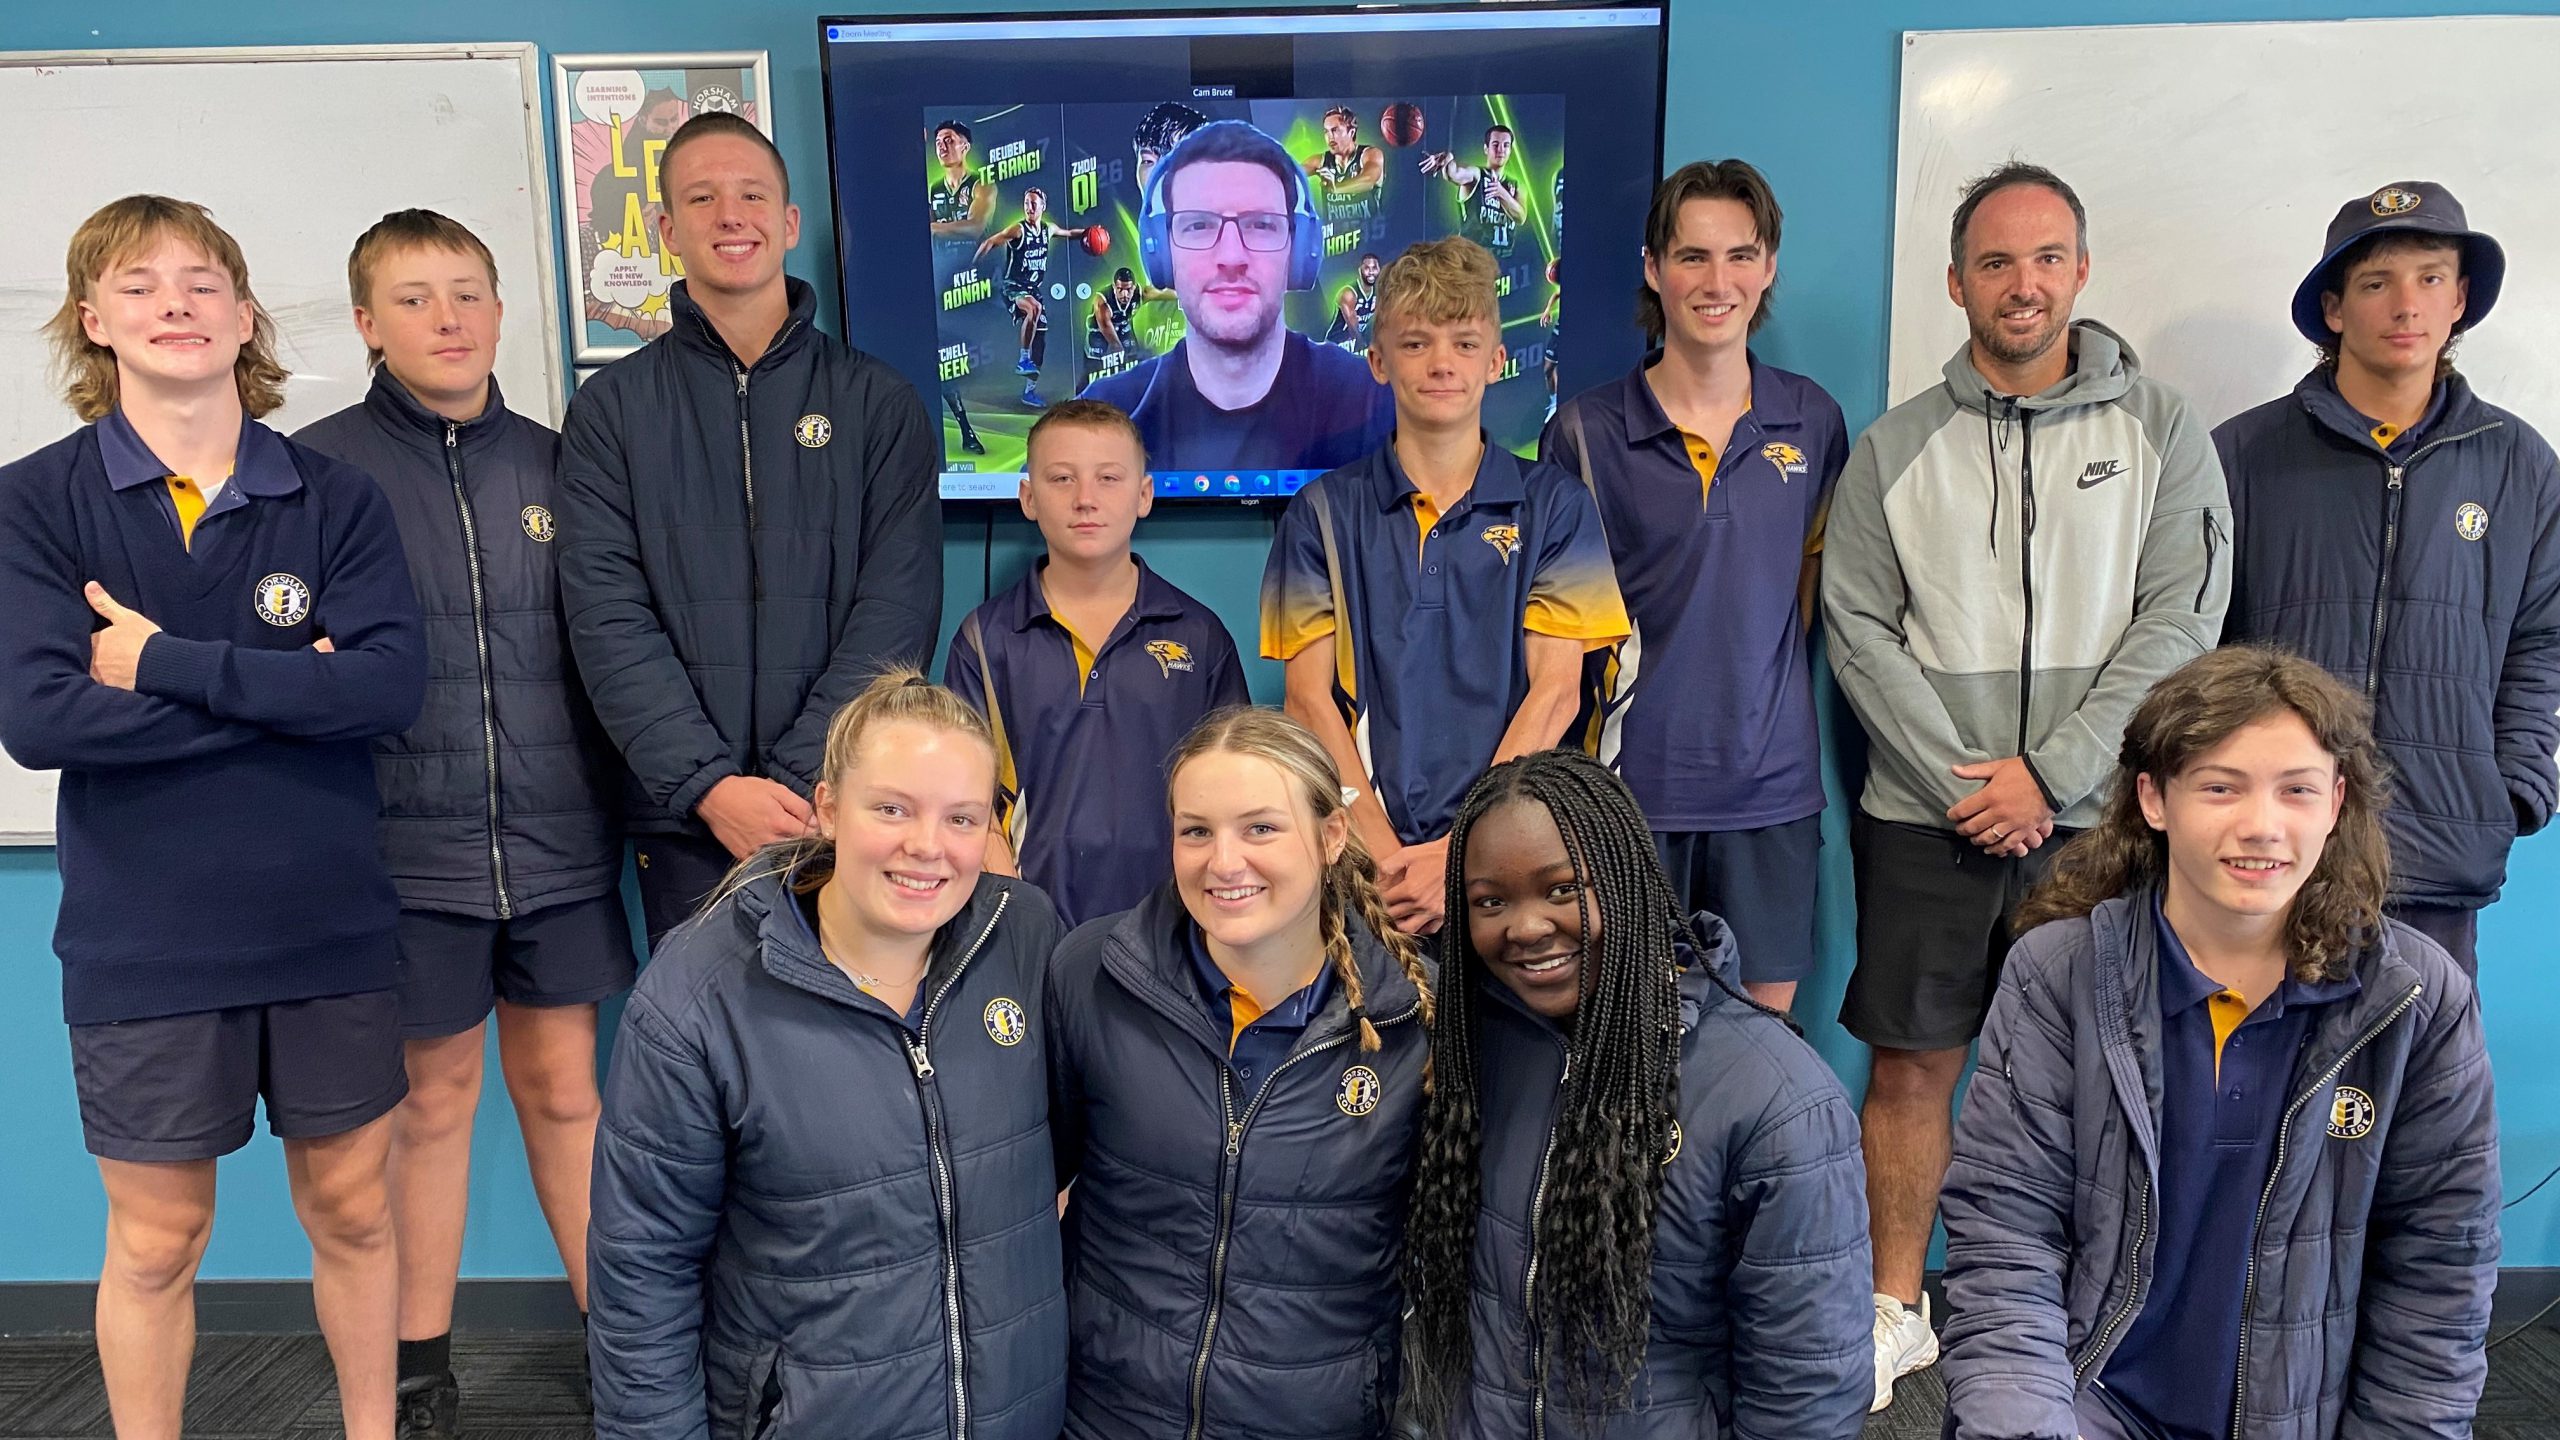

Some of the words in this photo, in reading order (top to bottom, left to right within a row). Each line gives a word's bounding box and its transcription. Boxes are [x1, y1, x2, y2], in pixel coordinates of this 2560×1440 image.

[692, 86, 739, 110] HORSHAM
[1192, 88, 1210, 97] Cam
[1211, 88, 1233, 97] Bruce
[989, 139, 1026, 163] REUBEN
[978, 164, 996, 186] TE
[998, 149, 1040, 181] RANGI
[1071, 155, 1097, 177] ZHOU
[1072, 170, 1097, 215] QI
[1326, 229, 1361, 257] HOFF
[614, 265, 638, 273] APPLY
[953, 268, 978, 288] KYLE
[604, 280, 652, 288] KNOWLEDGE
[1101, 350, 1125, 369] TREY
[2084, 459, 2119, 477] NIKE
[258, 575, 308, 599] HORSHAM
[257, 603, 306, 625] COLLEGE
[986, 1001, 1021, 1022] HORSHAM
[991, 1021, 1024, 1043] COLLEGE
[1340, 1069, 1378, 1090] HORSHAM
[1339, 1092, 1377, 1113] COLLEGE
[2334, 1089, 2371, 1112] RSHAM
[2326, 1118, 2371, 1136] OLLEGE
